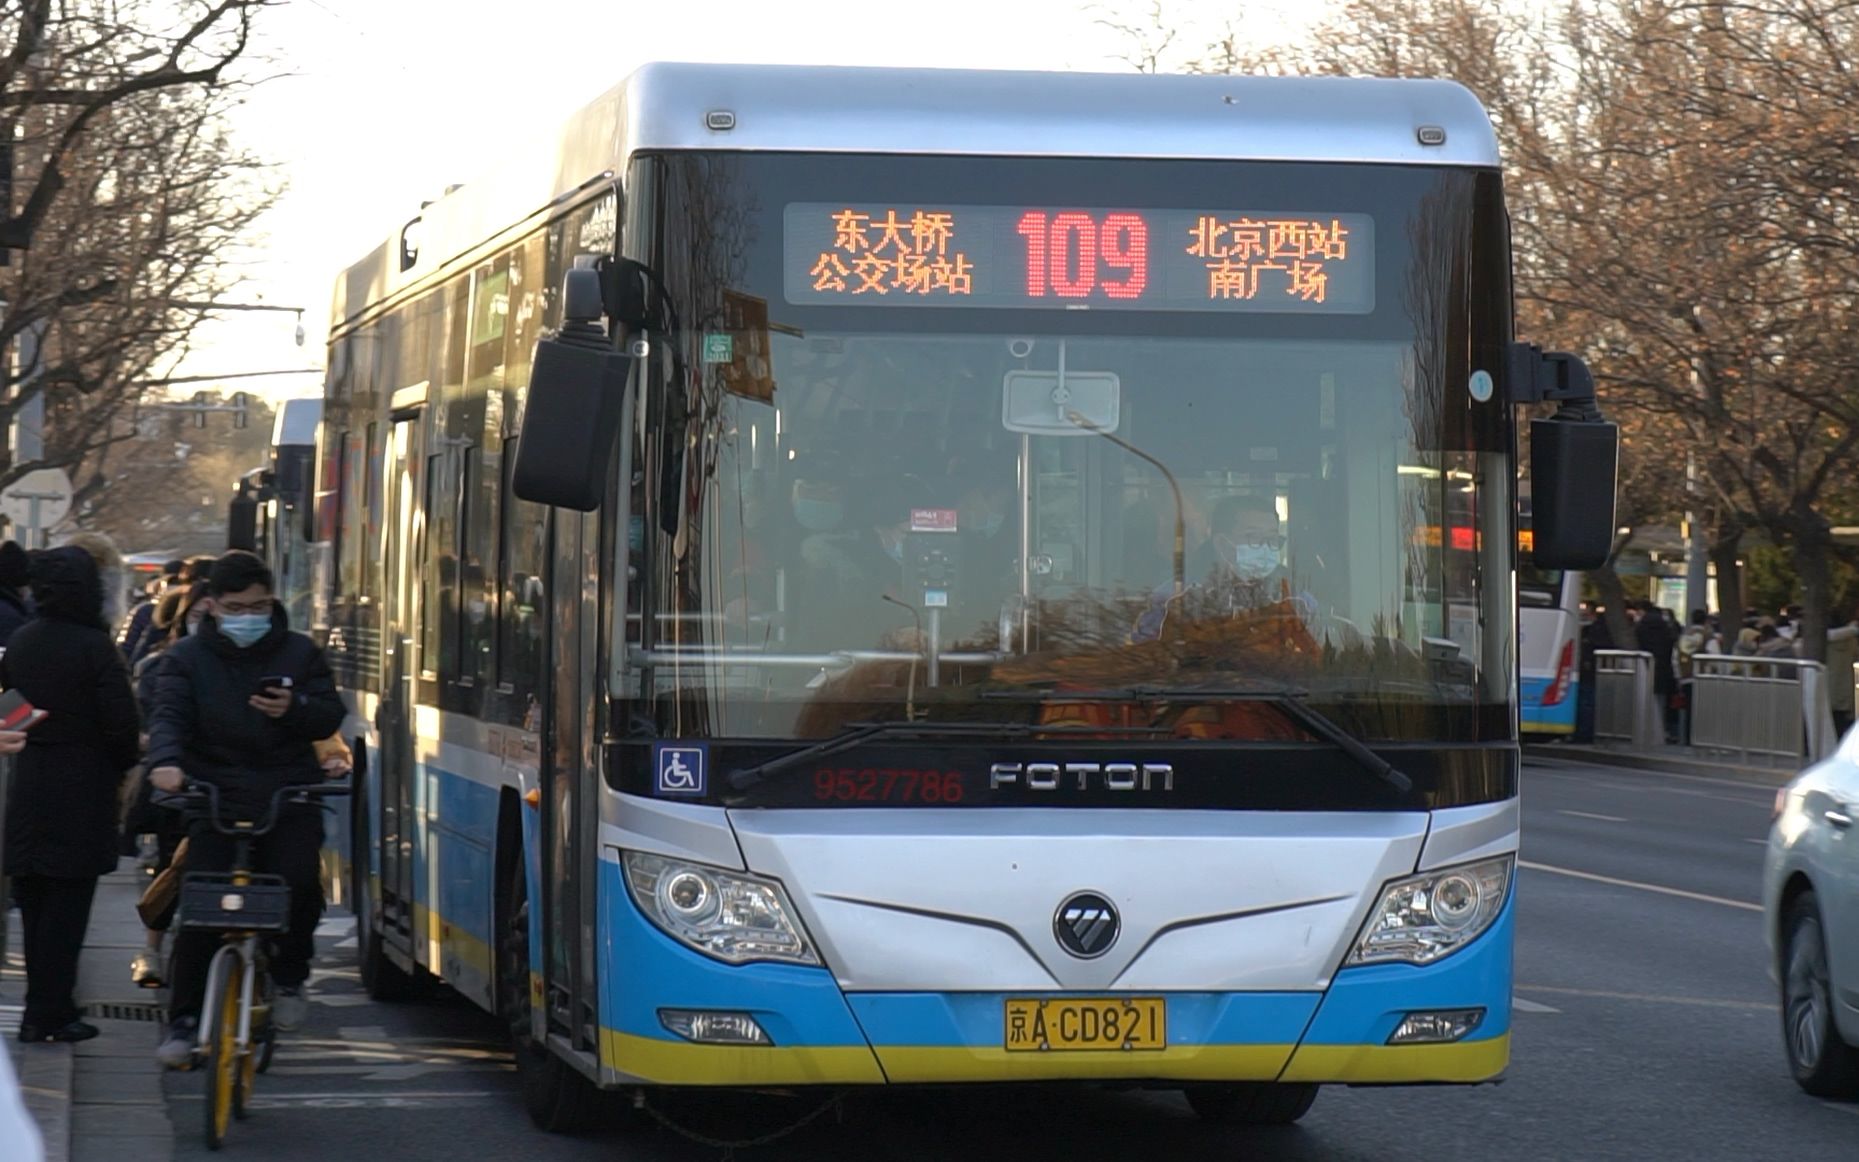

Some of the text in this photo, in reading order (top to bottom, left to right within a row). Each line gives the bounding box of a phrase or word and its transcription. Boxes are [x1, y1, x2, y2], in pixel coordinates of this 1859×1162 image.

[832, 210, 954, 254] 东大桥
[1186, 216, 1349, 260] 北京西站
[810, 252, 973, 294] 公交场站
[1017, 211, 1147, 299] 109
[1206, 258, 1327, 303] 南广场
[813, 769, 964, 802] 9527786
[989, 763, 1174, 791] FOTON
